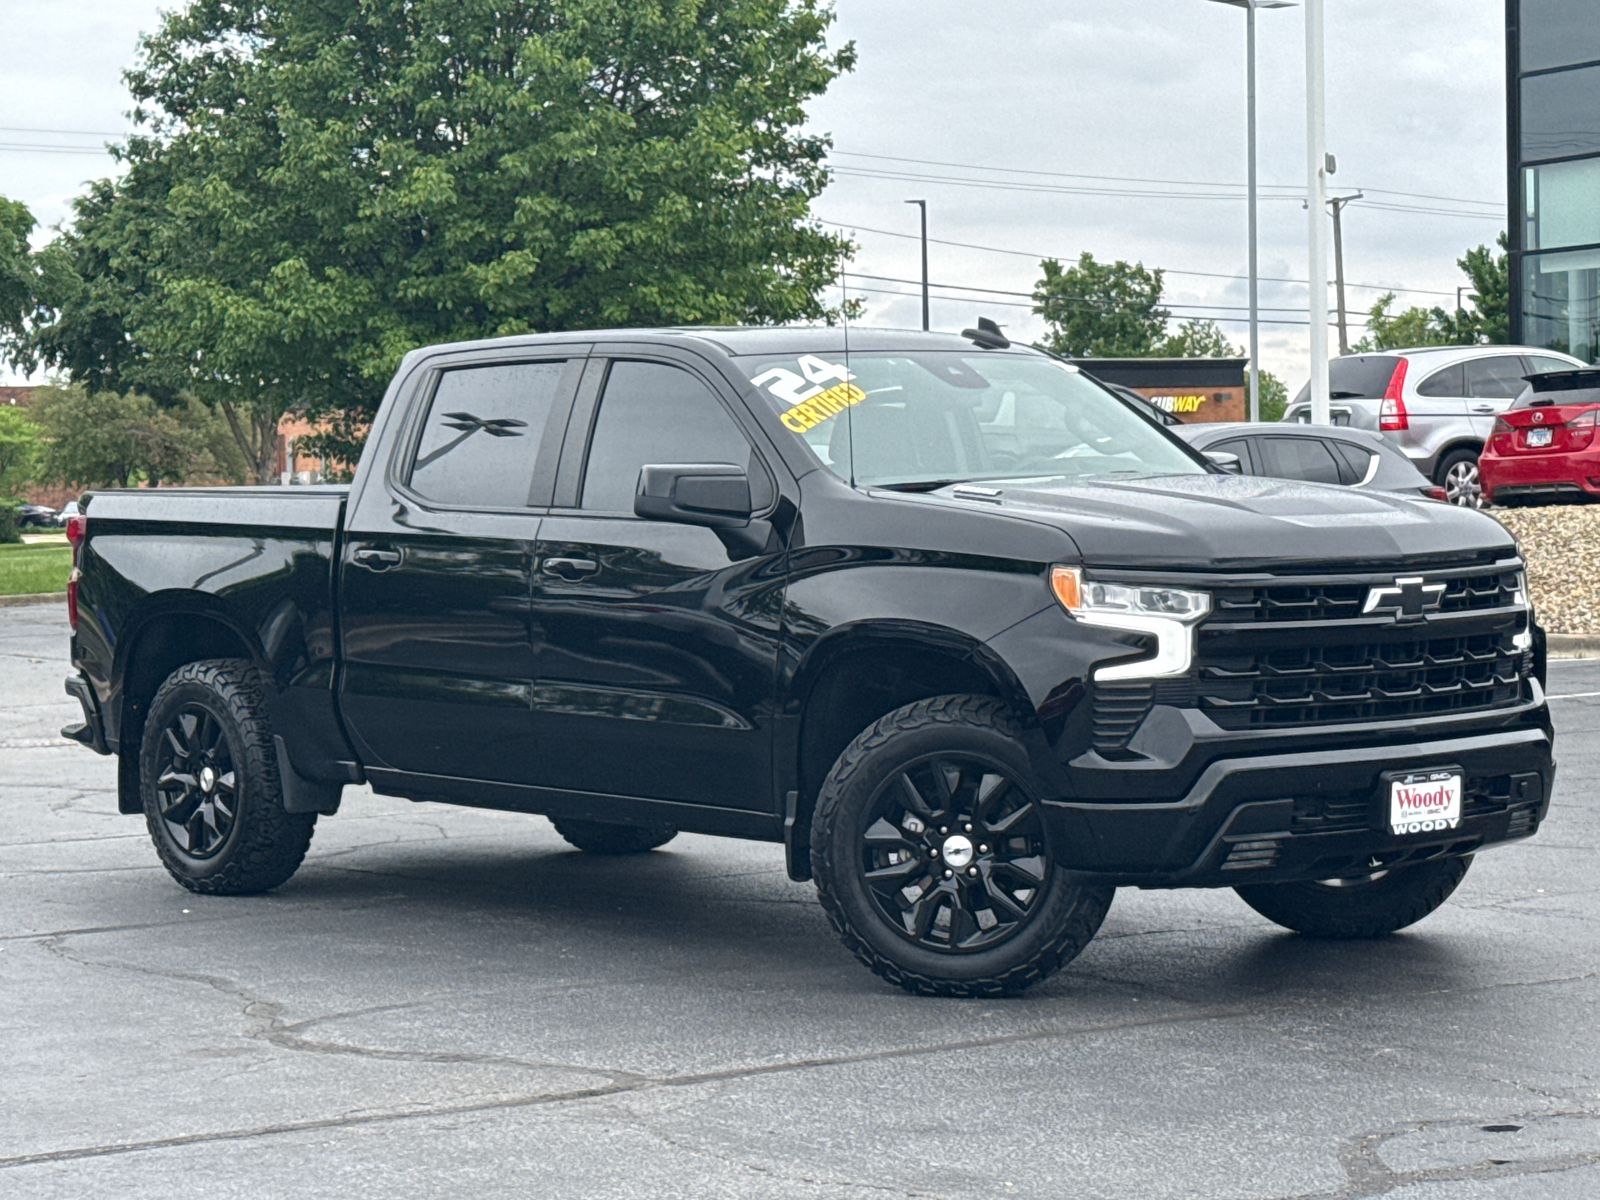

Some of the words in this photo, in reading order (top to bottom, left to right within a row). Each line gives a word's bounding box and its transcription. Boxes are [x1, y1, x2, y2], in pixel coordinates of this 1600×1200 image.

[750, 354, 857, 406] 24
[780, 382, 866, 433] CERTIFIED
[1396, 785, 1455, 811] Woody
[1392, 818, 1460, 835] WOODY
